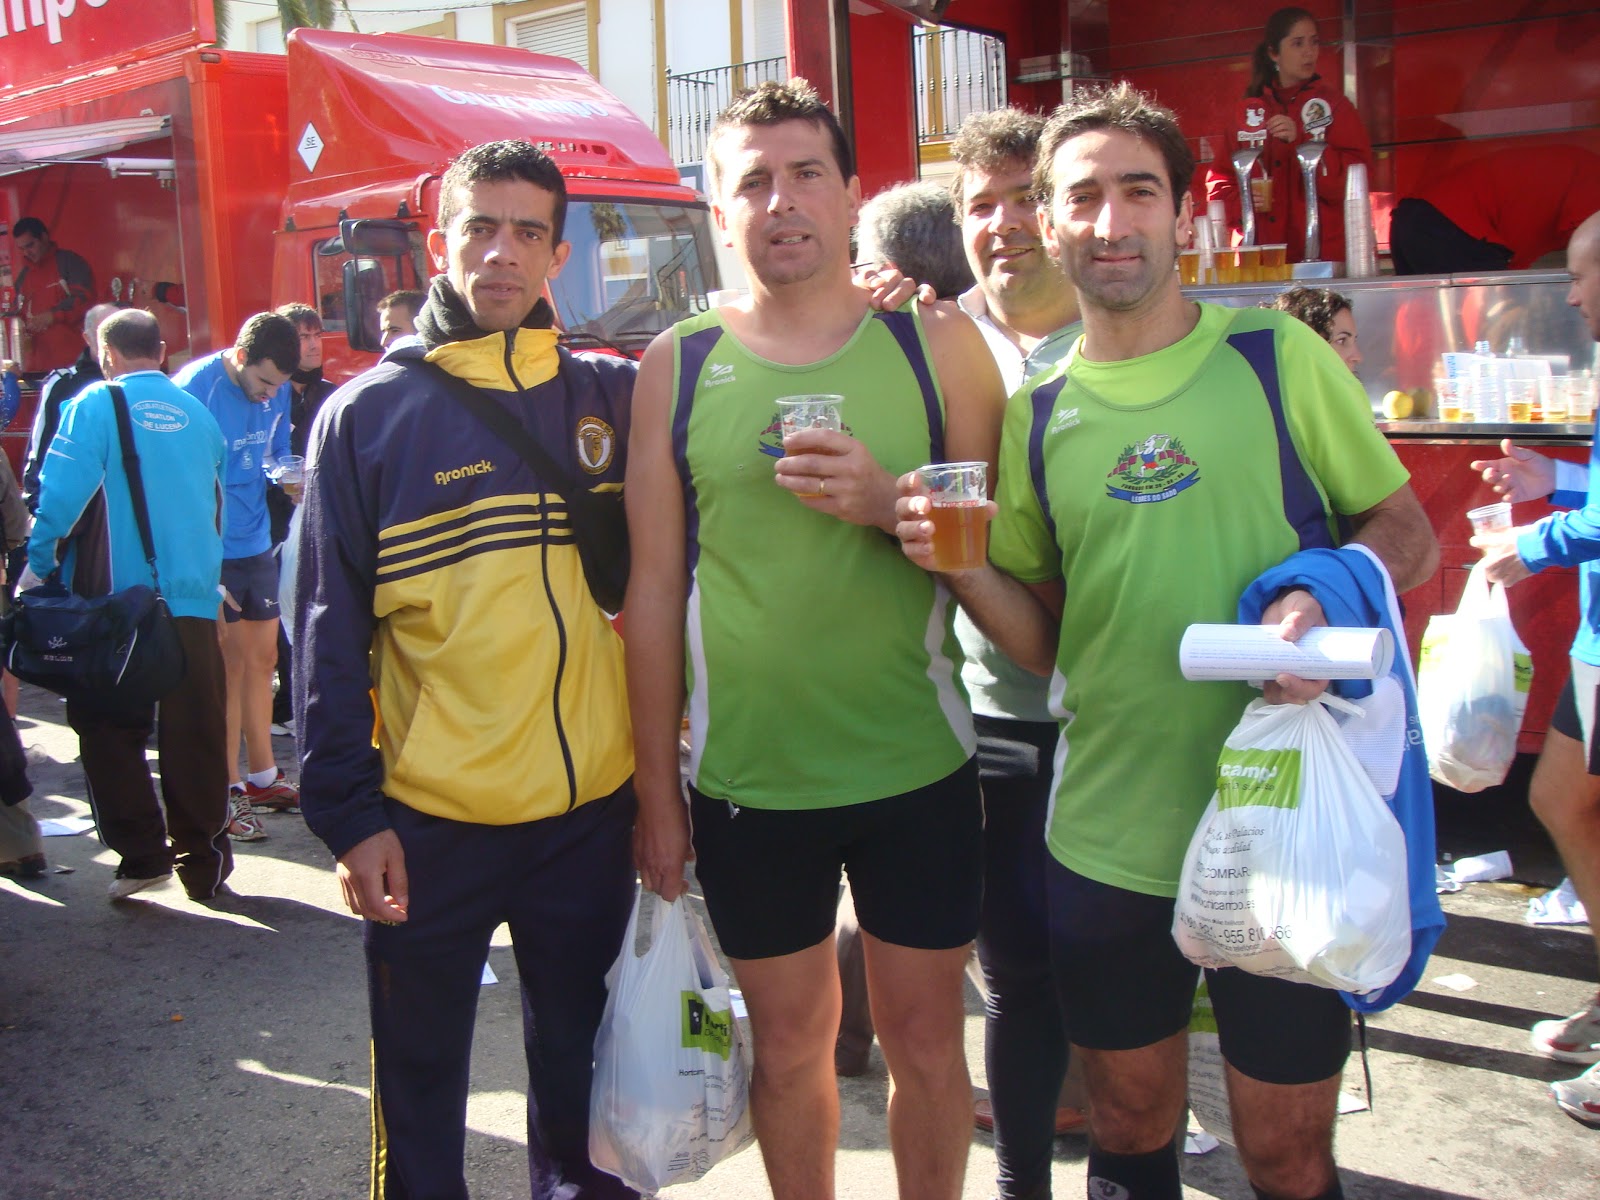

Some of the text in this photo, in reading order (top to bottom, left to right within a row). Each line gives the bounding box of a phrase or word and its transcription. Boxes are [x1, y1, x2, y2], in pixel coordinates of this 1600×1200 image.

[306, 136, 316, 147] SE
[143, 420, 183, 430] DE LUCENA
[1223, 928, 1246, 944] 955
